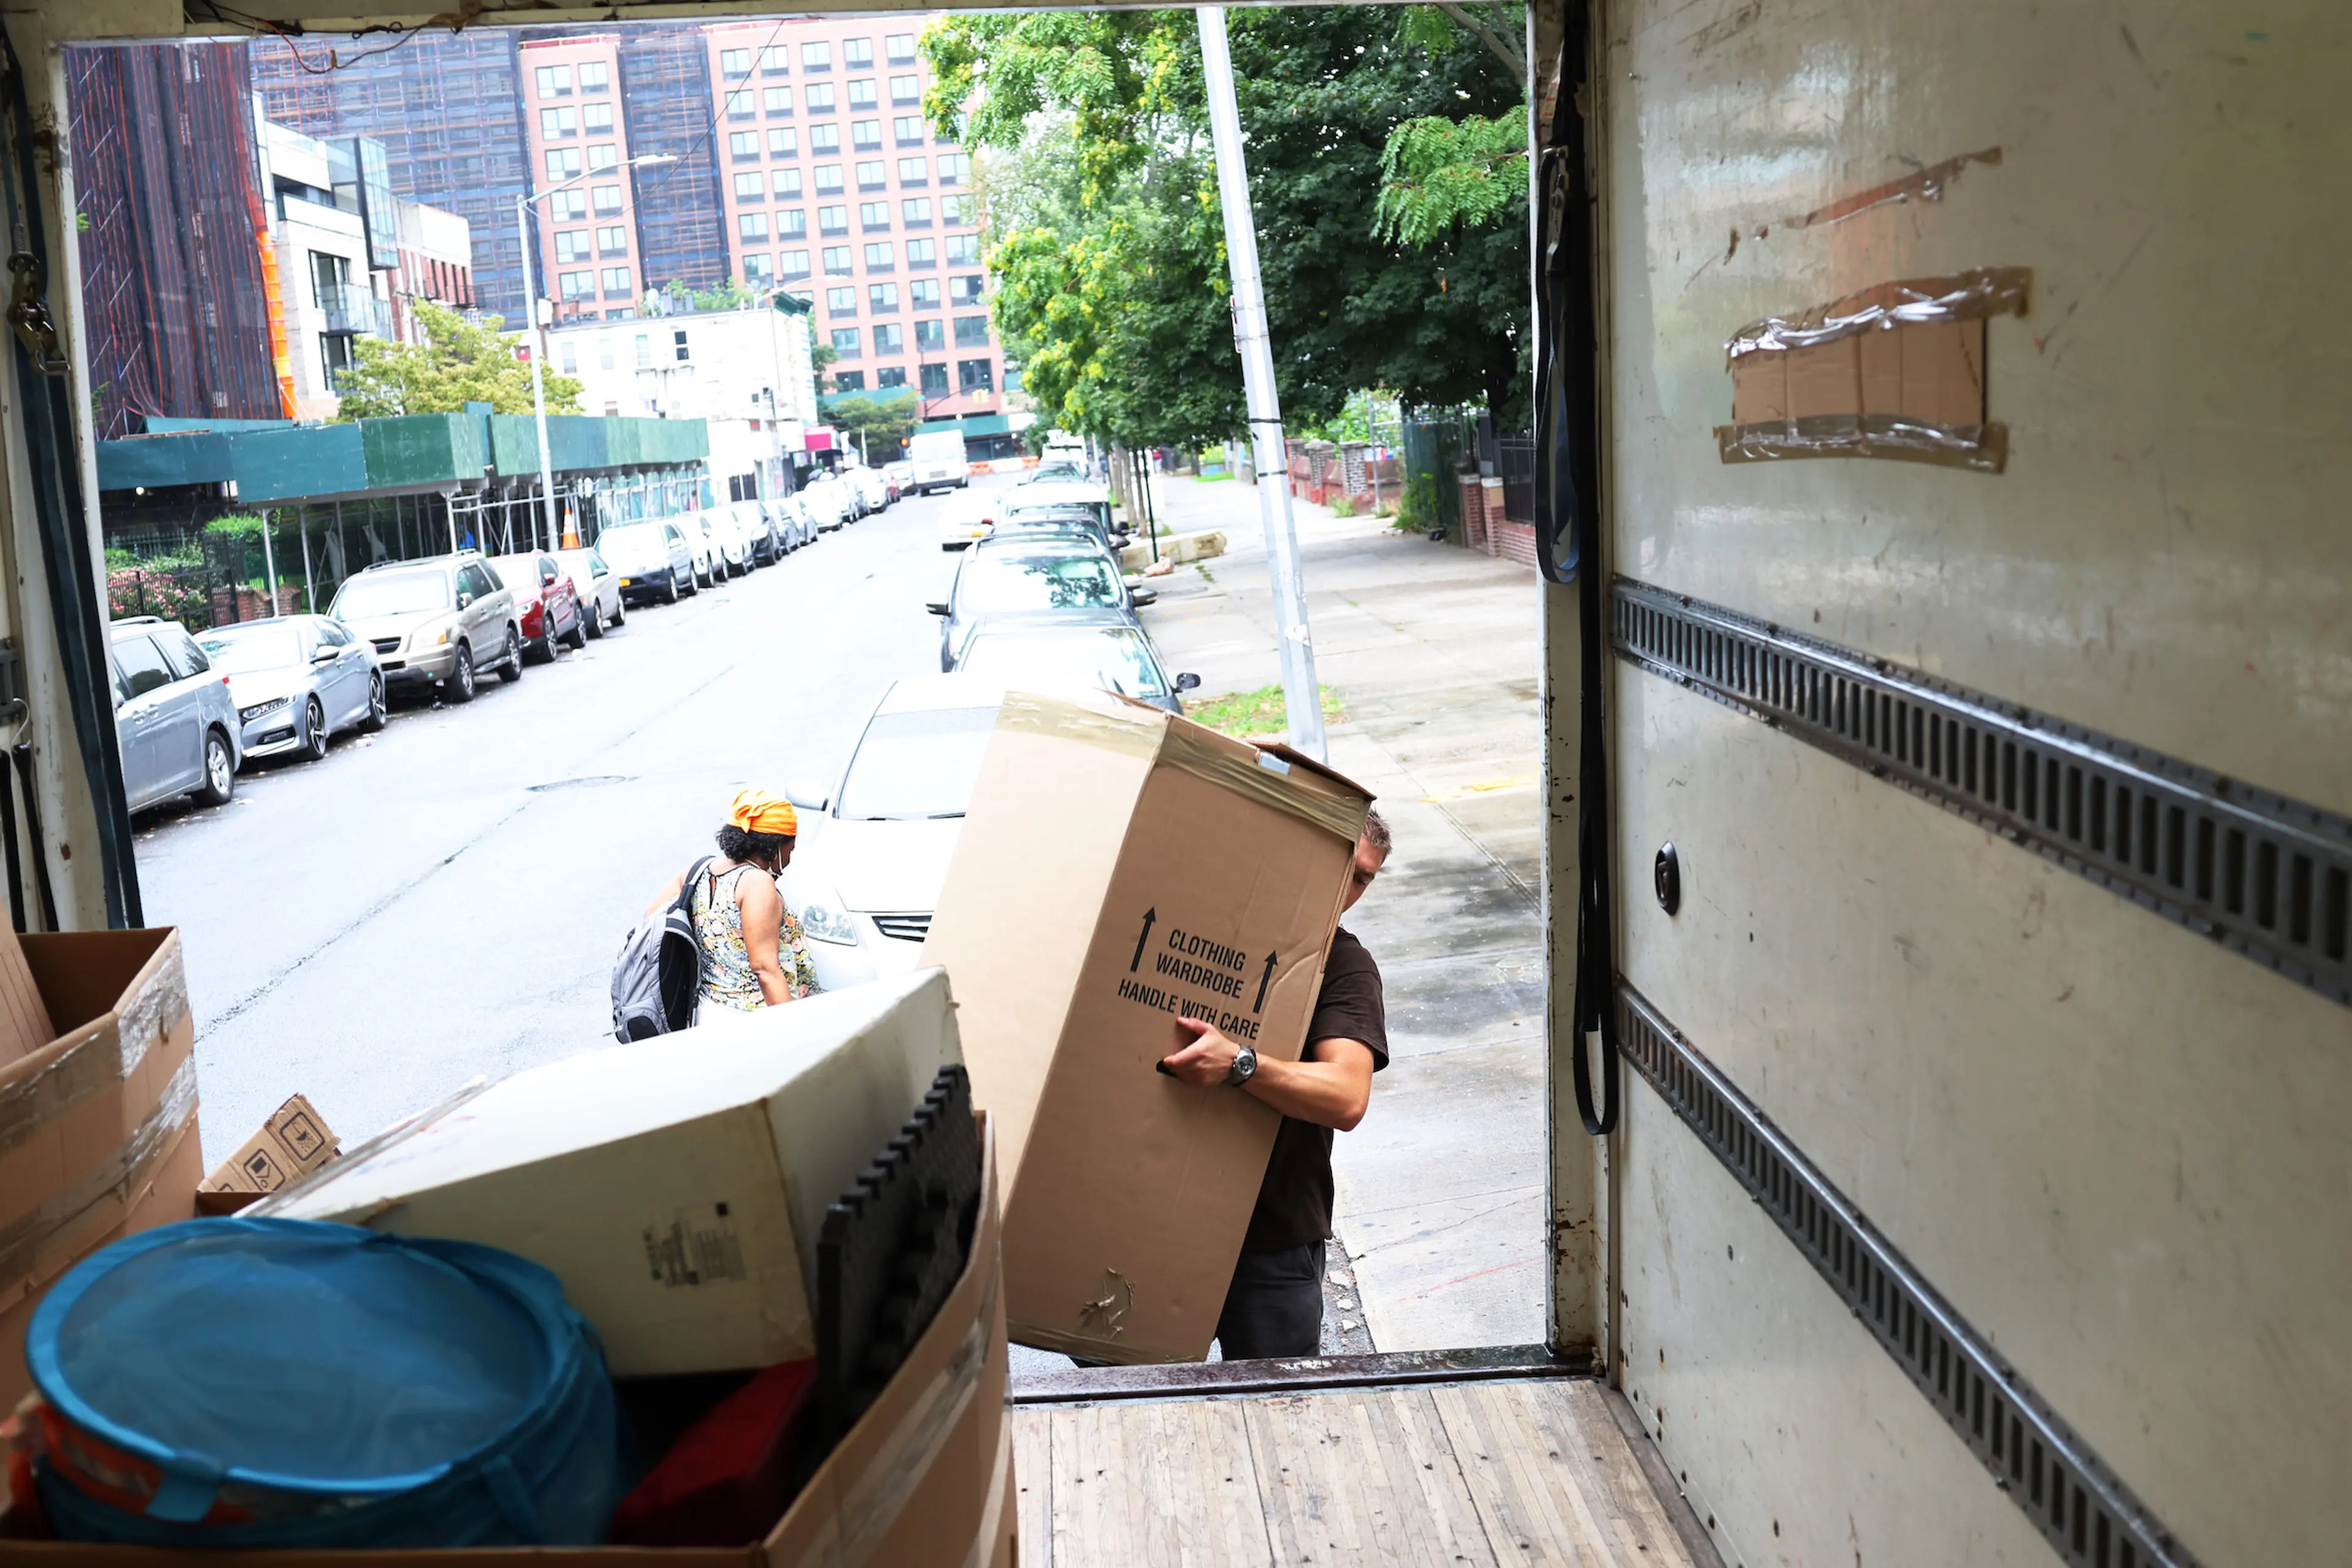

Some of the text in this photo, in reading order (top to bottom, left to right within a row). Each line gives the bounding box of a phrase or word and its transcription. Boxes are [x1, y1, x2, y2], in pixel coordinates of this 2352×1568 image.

[1169, 929, 1246, 971] CLOTHING
[1156, 952, 1244, 999] WARDROBE
[1118, 978, 1260, 1040] HANDLE WITH CARE
